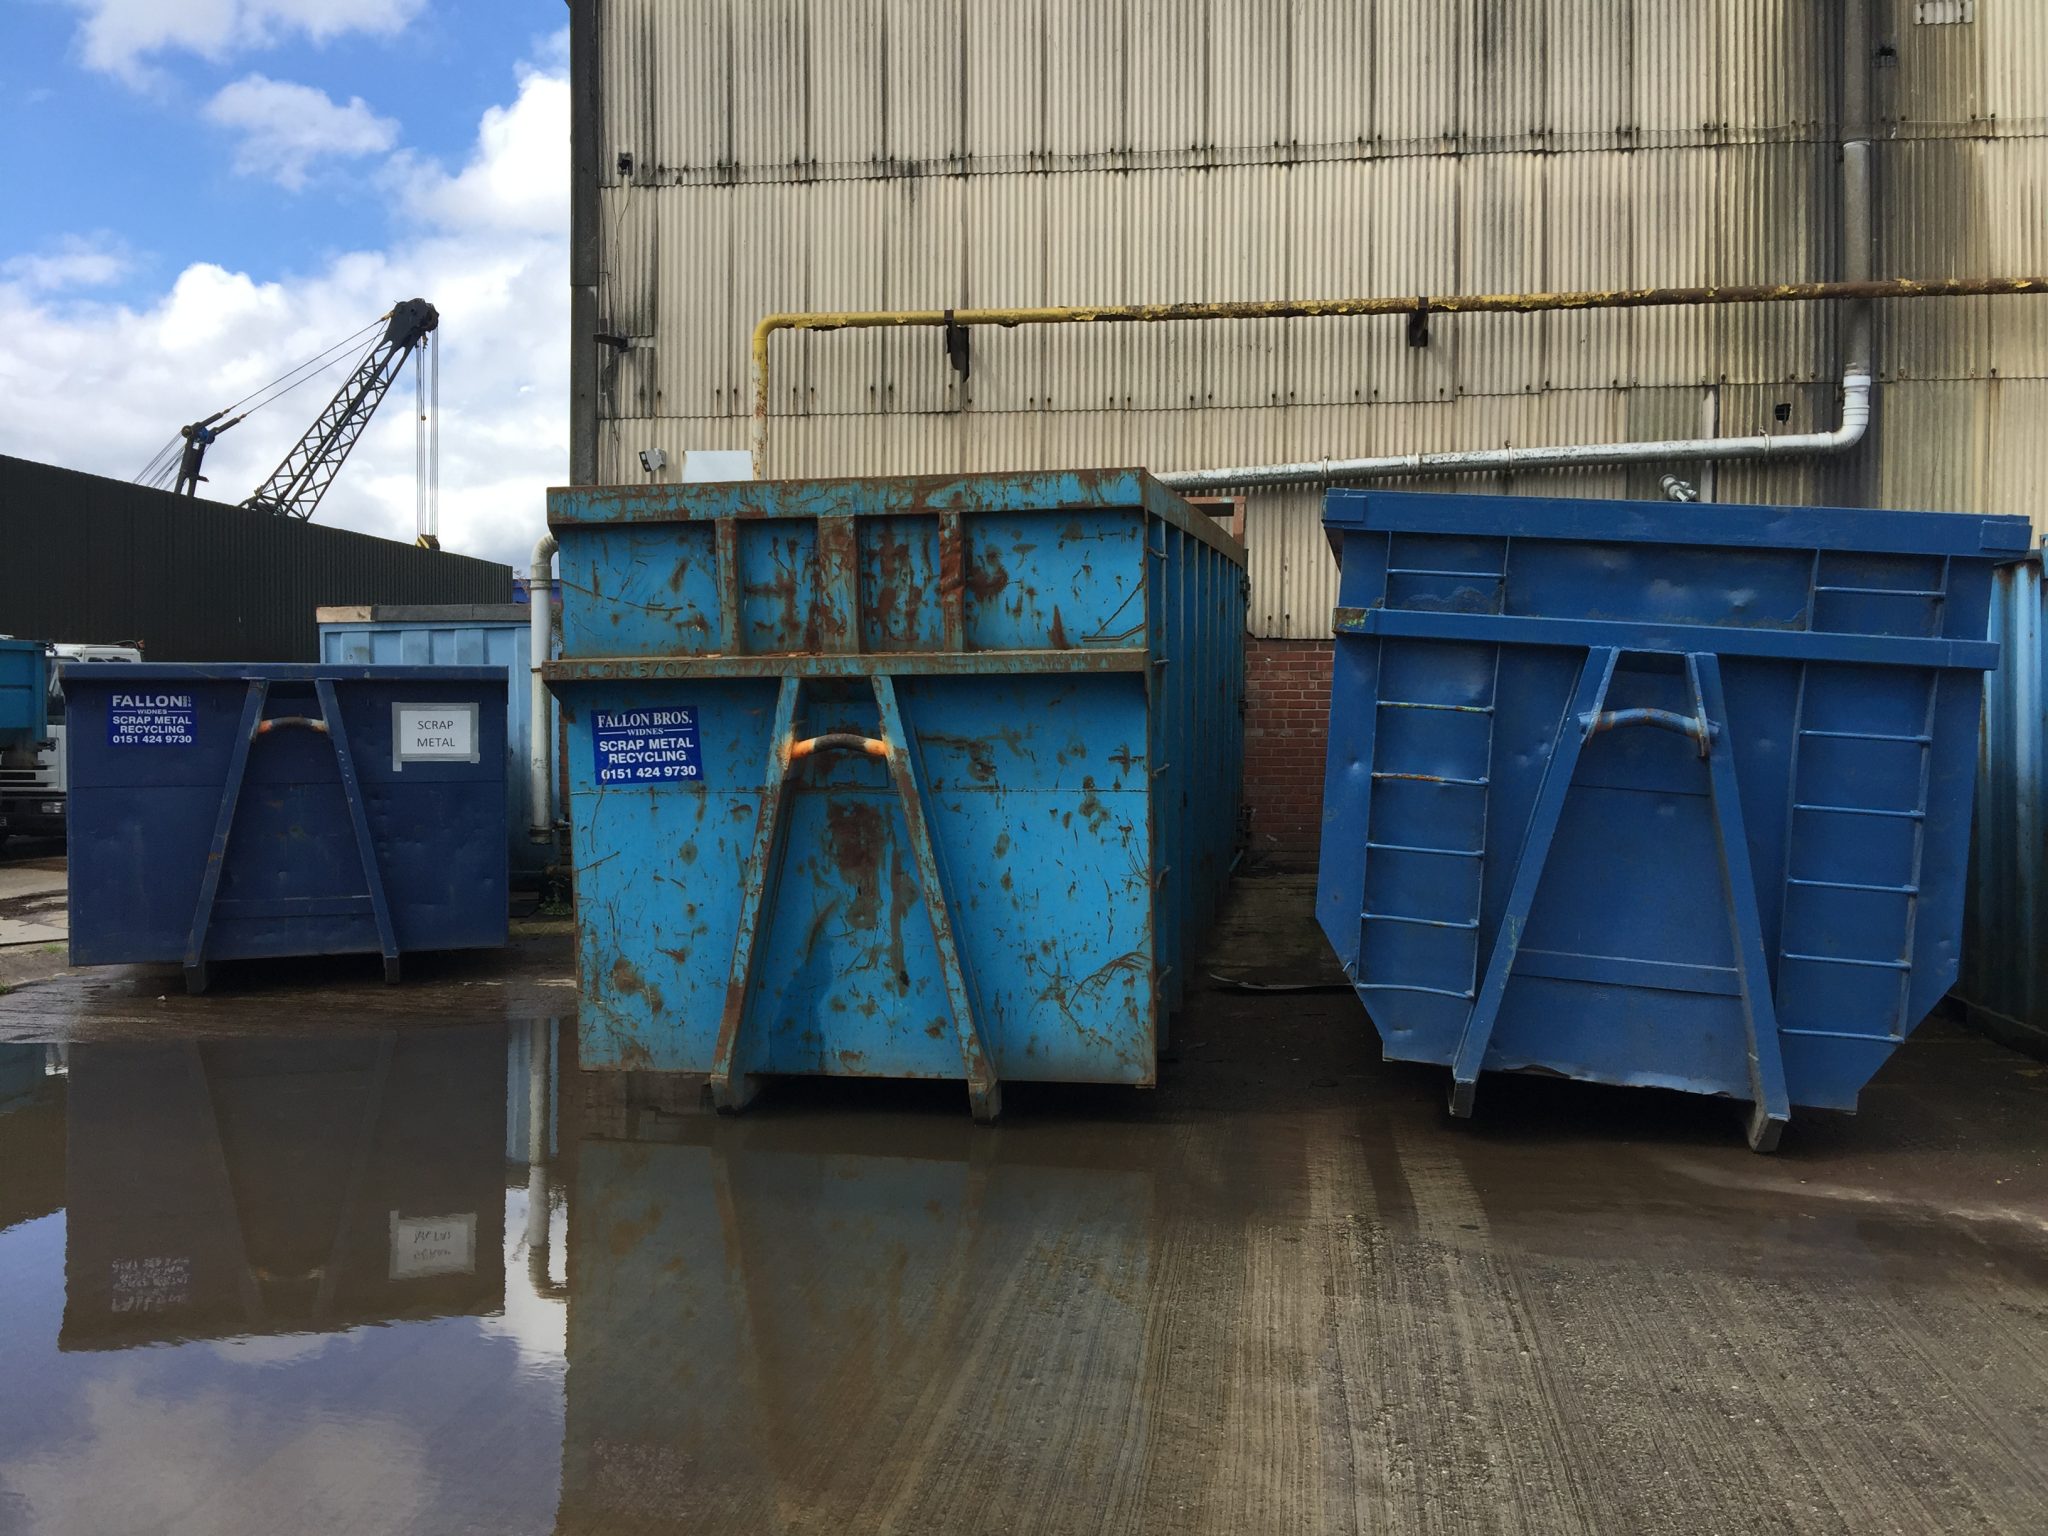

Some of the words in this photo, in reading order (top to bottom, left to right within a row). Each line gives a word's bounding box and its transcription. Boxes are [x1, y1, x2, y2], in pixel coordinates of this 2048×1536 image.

[112, 695, 182, 707] FALLON
[112, 716, 151, 724] SCRAP
[154, 716, 192, 724] METAL
[598, 712, 650, 728] FALLON
[653, 710, 693, 725] BROS.
[120, 725, 185, 733] RECYCLING
[417, 720, 454, 730] SCRAP
[627, 728, 664, 736] WIDNES
[112, 735, 138, 743] 0151
[142, 735, 162, 743] 424
[165, 735, 192, 743] 9730
[417, 737, 455, 747] METAL
[600, 739, 644, 752] SCRAP
[649, 737, 694, 750] METAL
[608, 750, 687, 763] RECYCLING
[601, 768, 632, 780] 0151
[636, 767, 661, 778] 424
[664, 765, 697, 777] 9730
